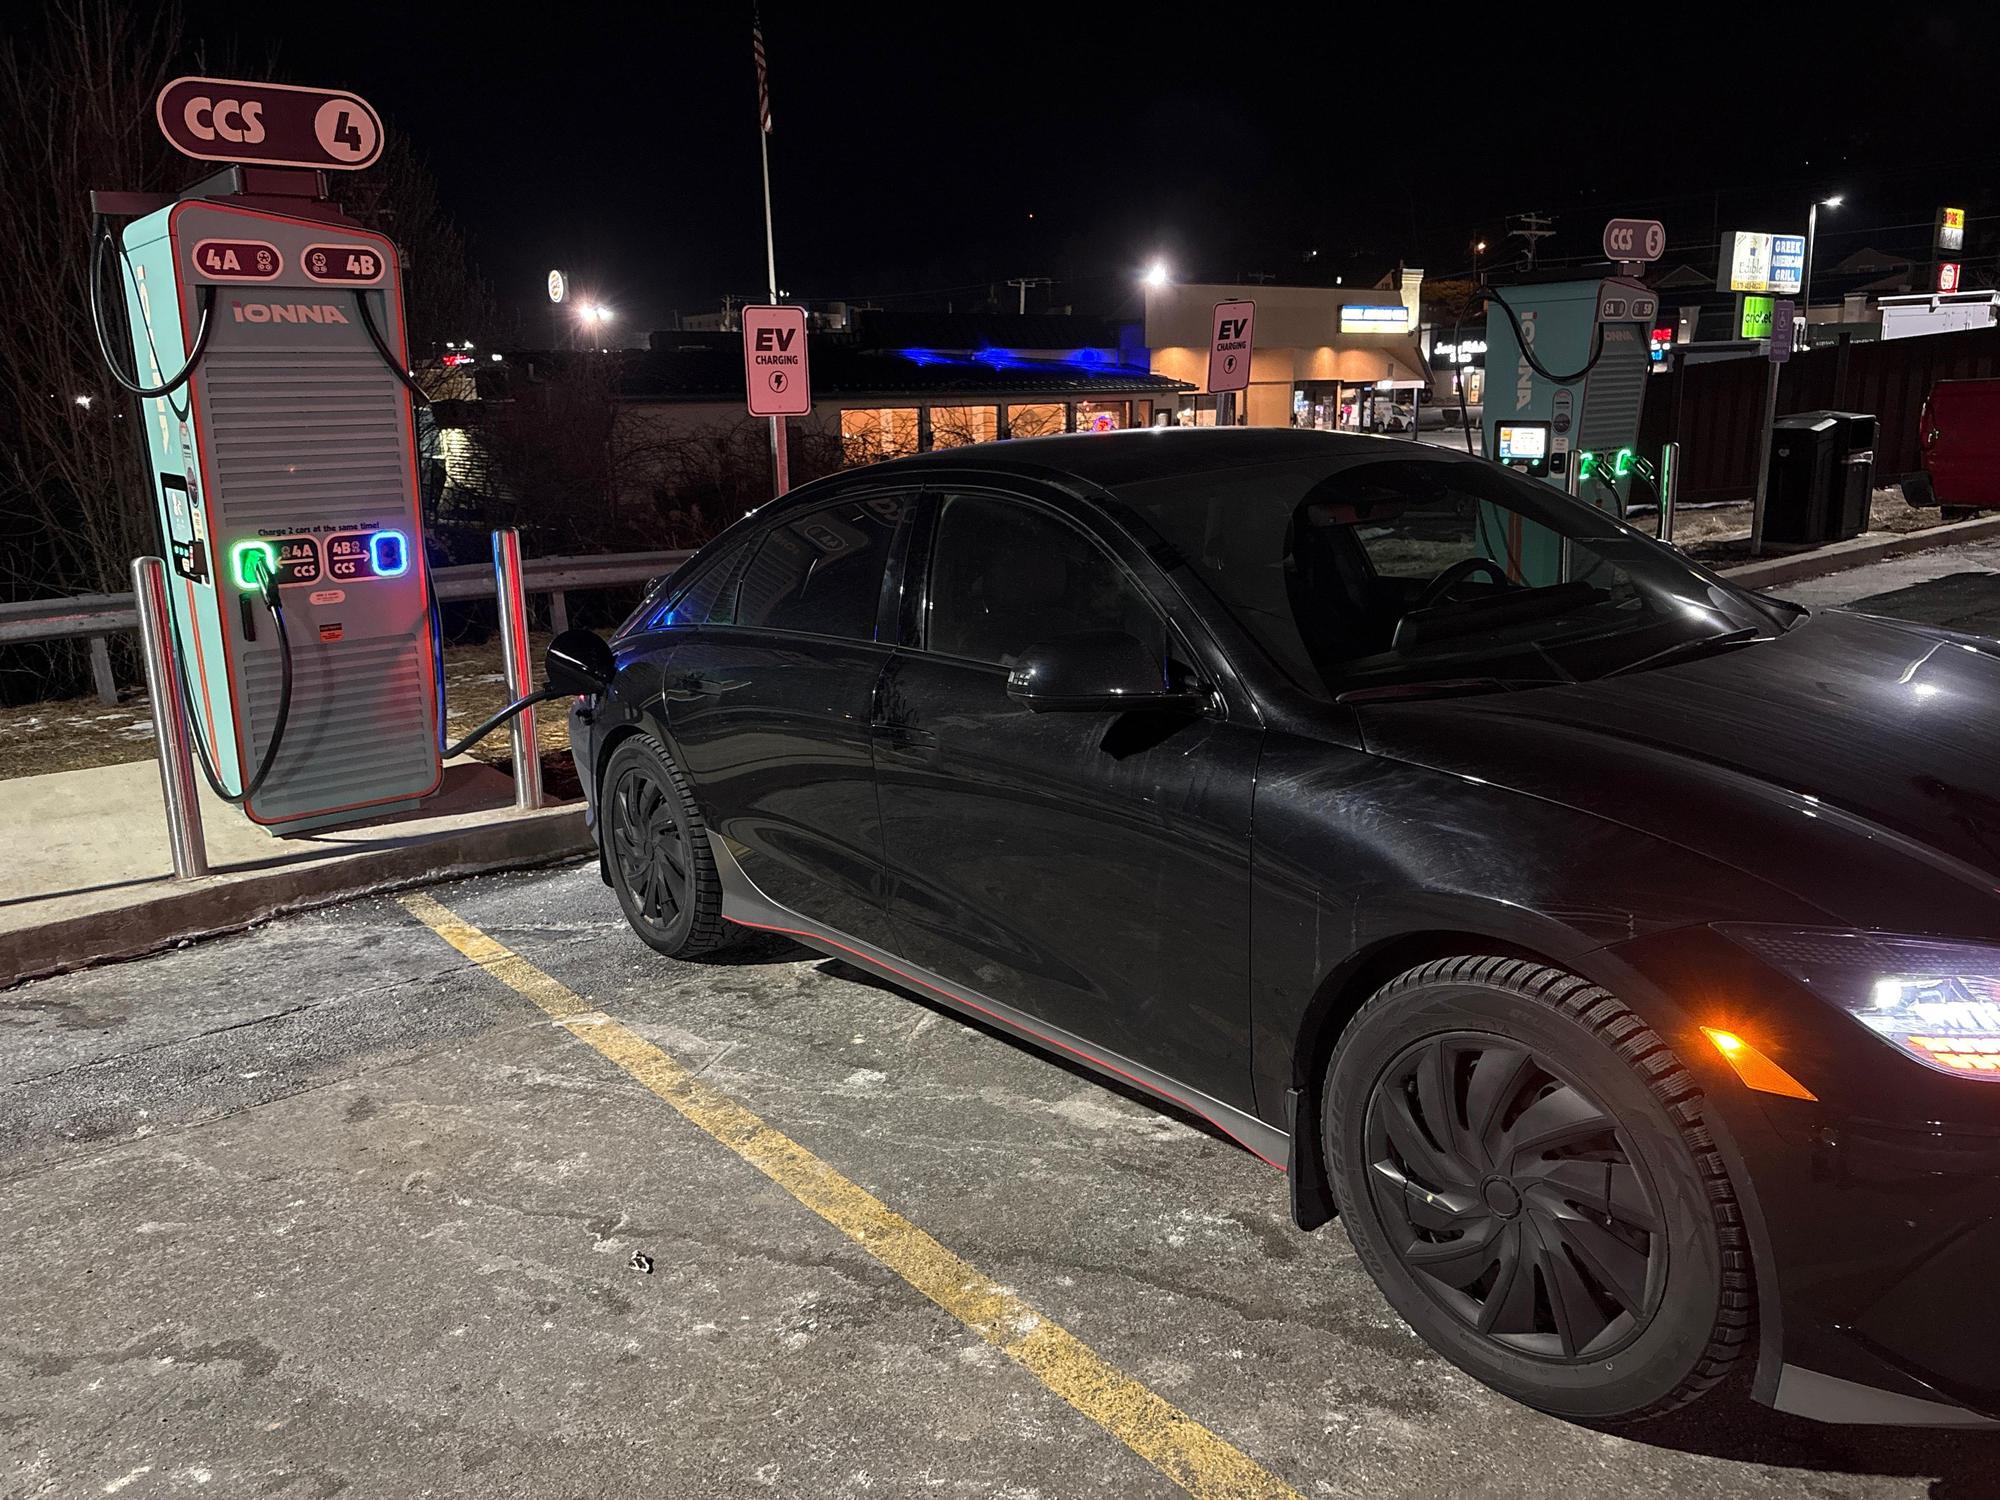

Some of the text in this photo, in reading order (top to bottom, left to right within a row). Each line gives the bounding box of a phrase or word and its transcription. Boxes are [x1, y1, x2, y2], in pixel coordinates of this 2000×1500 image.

[184, 96, 266, 144] CCS
[333, 111, 362, 152] 4
[1610, 228, 1633, 250] CCS
[1650, 231, 1658, 248] 5
[1774, 240, 1802, 254] GREEK
[205, 249, 241, 272] 4A
[346, 253, 375, 276] 4B
[1739, 258, 1763, 274] Edible
[1774, 268, 1796, 281] GRILL
[1217, 318, 1249, 341] EV
[755, 327, 797, 352] EV
[1216, 341, 1247, 352] CHARGING
[755, 355, 799, 365] CHARGING
[257, 528, 287, 537] Charge
[288, 527, 294, 535] 2
[338, 524, 359, 532] same
[360, 521, 380, 530] time!
[292, 543, 314, 558] 4A
[332, 541, 352, 555] 4B
[293, 565, 316, 578] CCS
[333, 562, 356, 574] CCS
